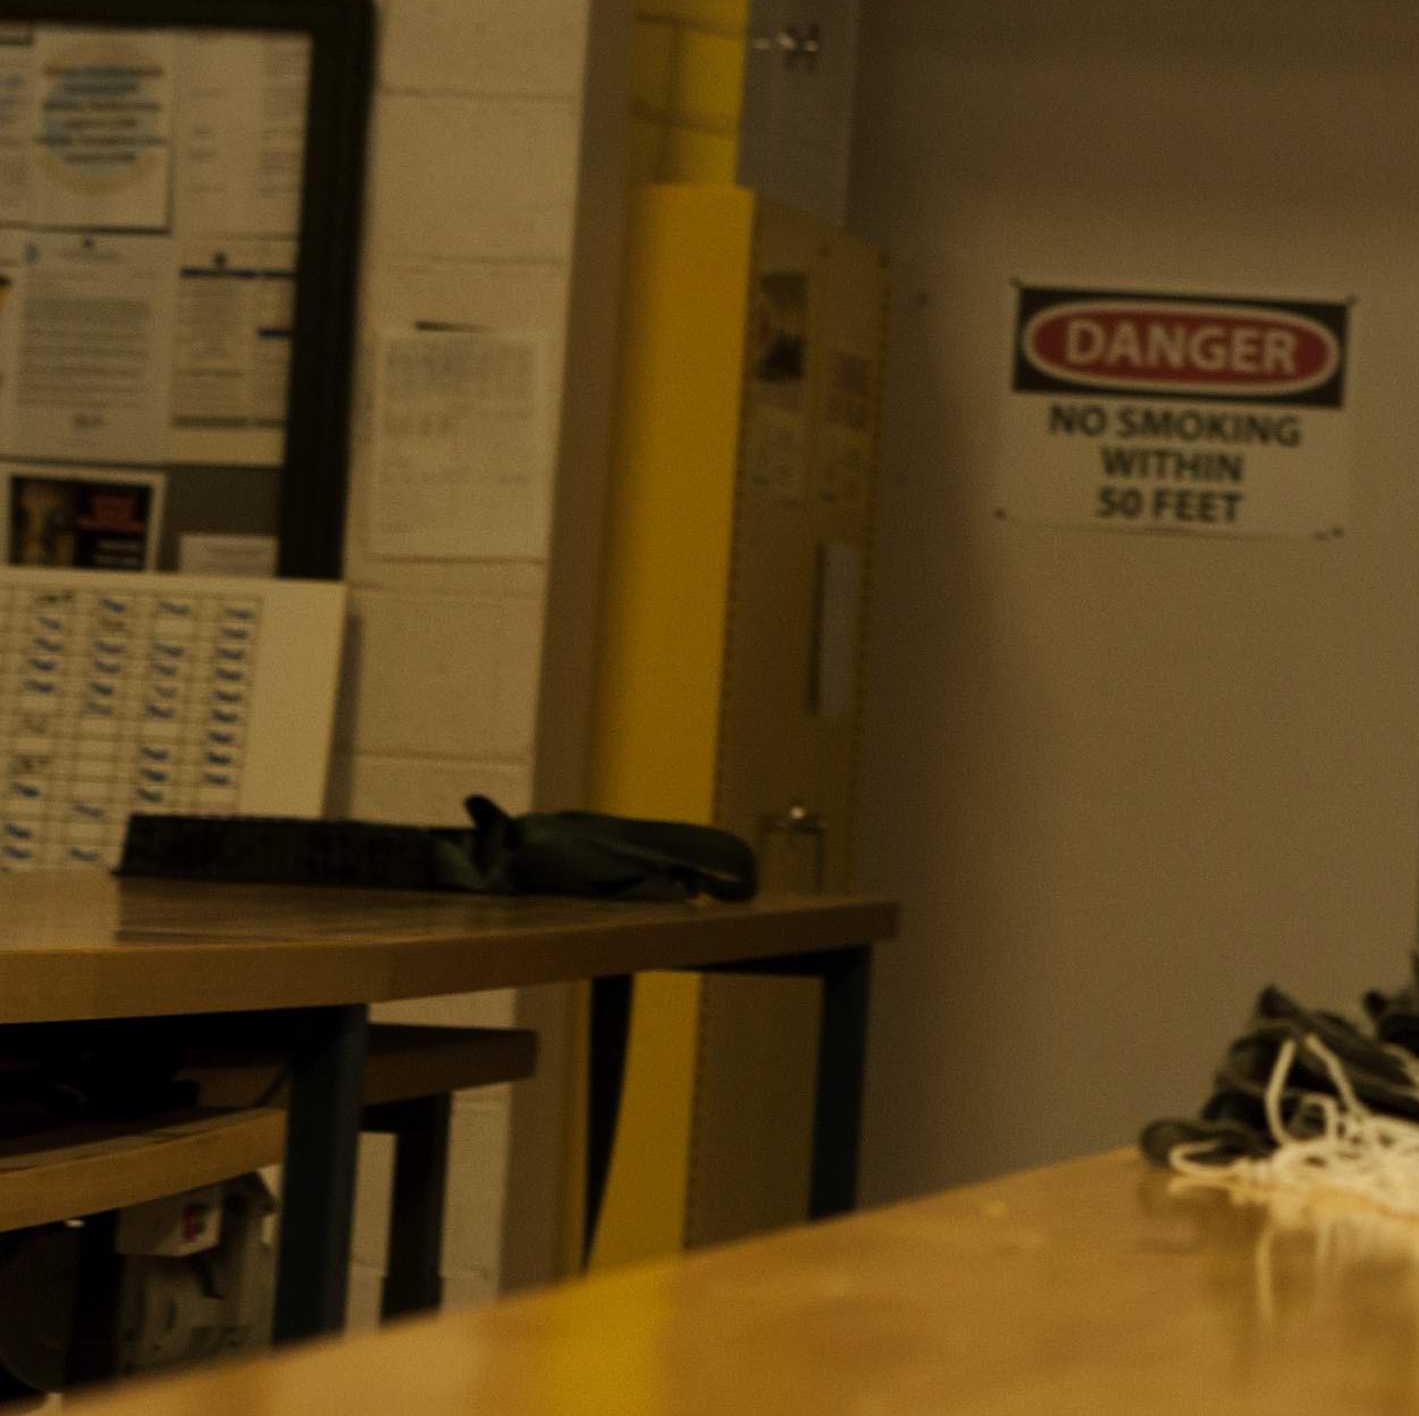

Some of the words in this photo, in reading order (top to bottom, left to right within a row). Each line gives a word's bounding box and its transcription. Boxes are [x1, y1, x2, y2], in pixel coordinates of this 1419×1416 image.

[1064, 318, 1297, 375] DANGER
[1050, 404, 1106, 436] NO
[1119, 407, 1300, 447] SMOKING
[1102, 448, 1243, 483] WITHIN
[1097, 489, 1143, 518] 50
[1153, 490, 1243, 522] FEET
